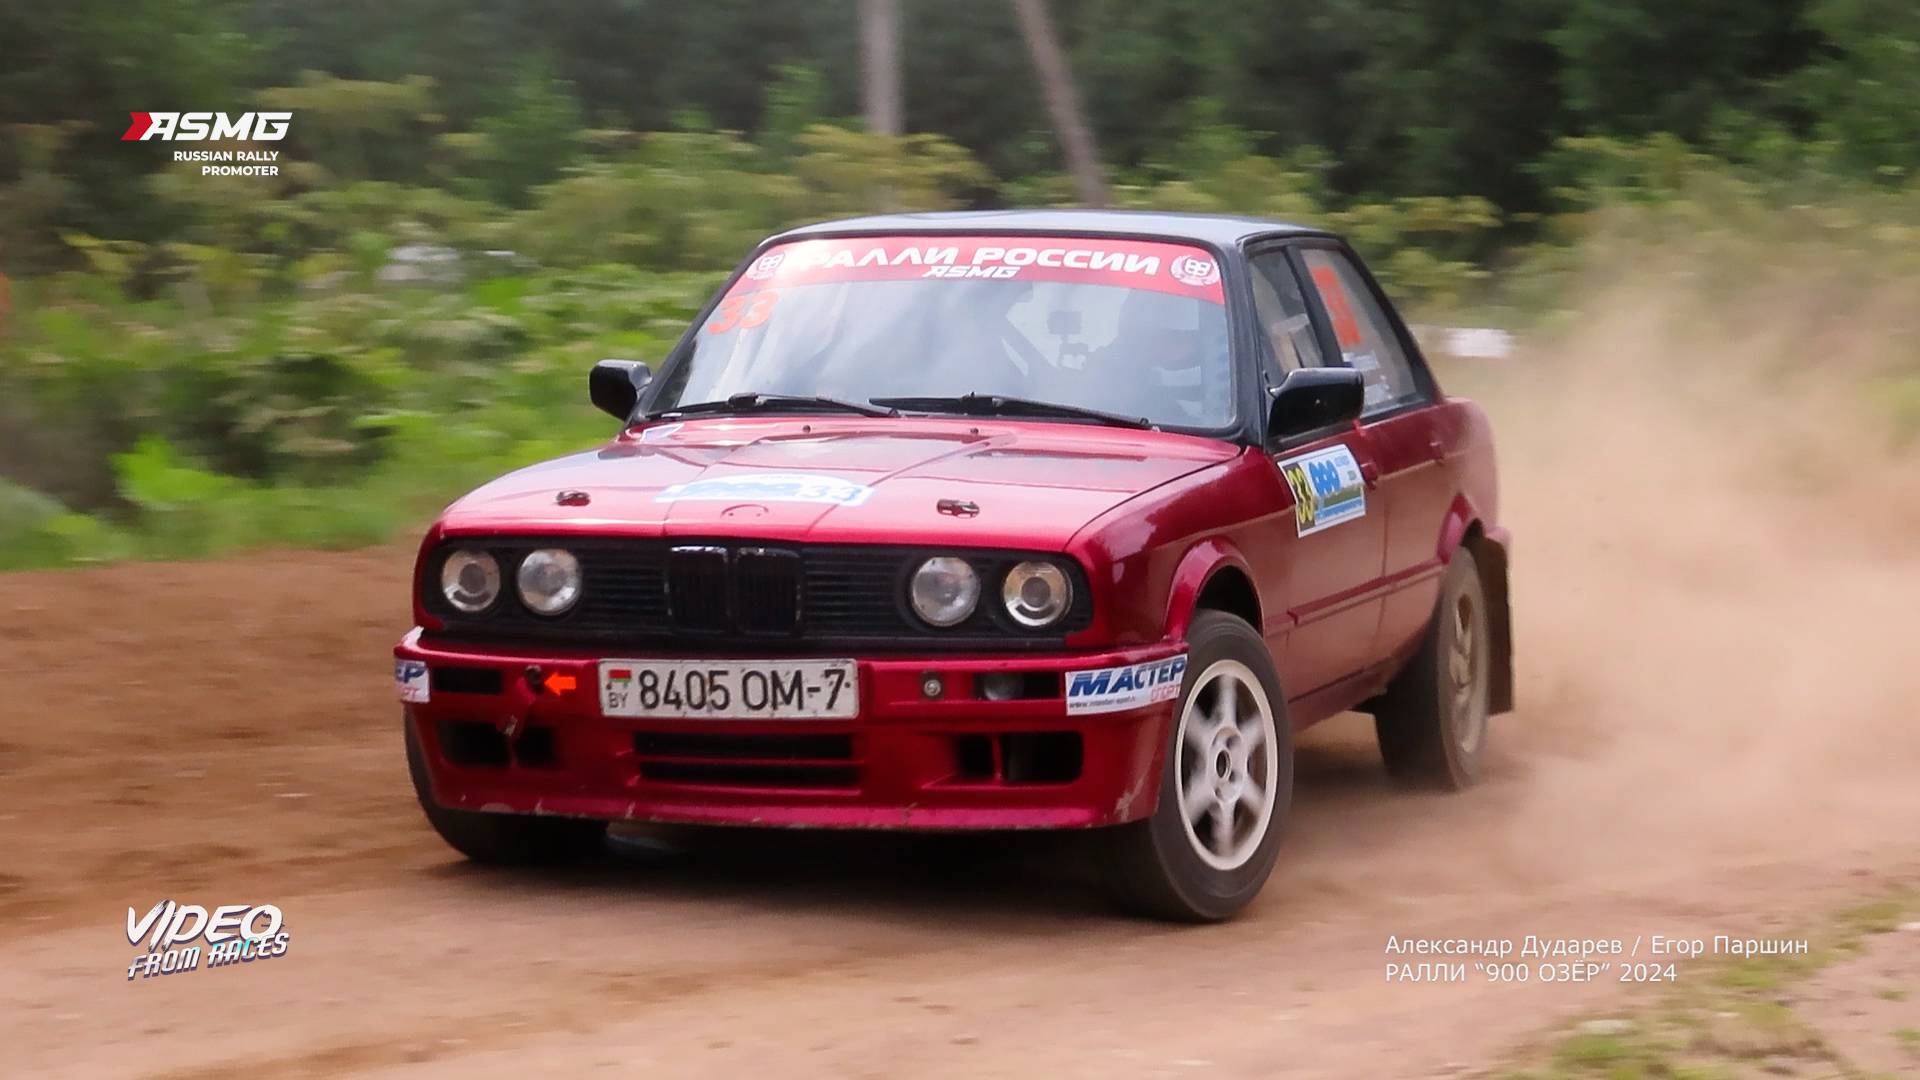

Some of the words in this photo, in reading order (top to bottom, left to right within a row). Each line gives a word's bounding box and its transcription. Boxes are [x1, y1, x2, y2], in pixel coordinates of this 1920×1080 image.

[922, 265, 1021, 279] ASMG
[972, 247, 1160, 275] РОССИИ
[708, 290, 779, 335] 33
[638, 669, 730, 711] 8405
[741, 668, 846, 711] OM-7
[1068, 656, 1186, 697] МАСТЕР
[608, 692, 629, 708] BY
